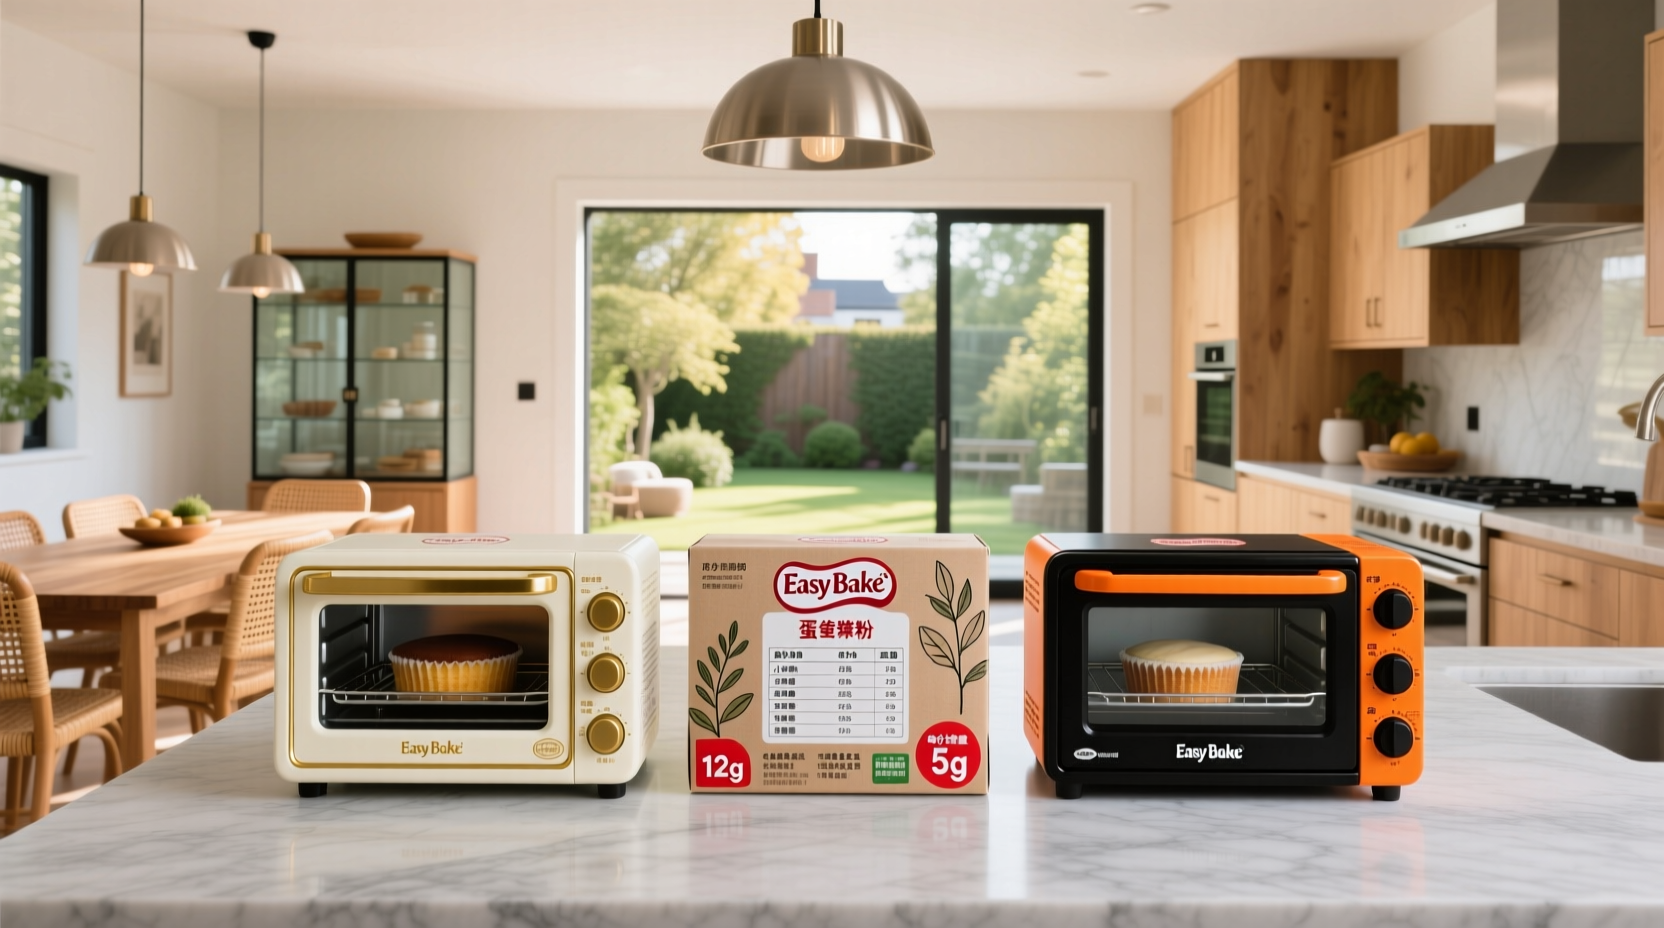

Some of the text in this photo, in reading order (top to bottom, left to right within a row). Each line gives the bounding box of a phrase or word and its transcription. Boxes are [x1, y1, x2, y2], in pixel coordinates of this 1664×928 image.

[783, 570, 888, 600] Easy Bake
[401, 740, 429, 758] Easy
[1176, 743, 1244, 763] Easy Bake
[702, 754, 744, 784] 12g
[931, 747, 968, 783] 5g
